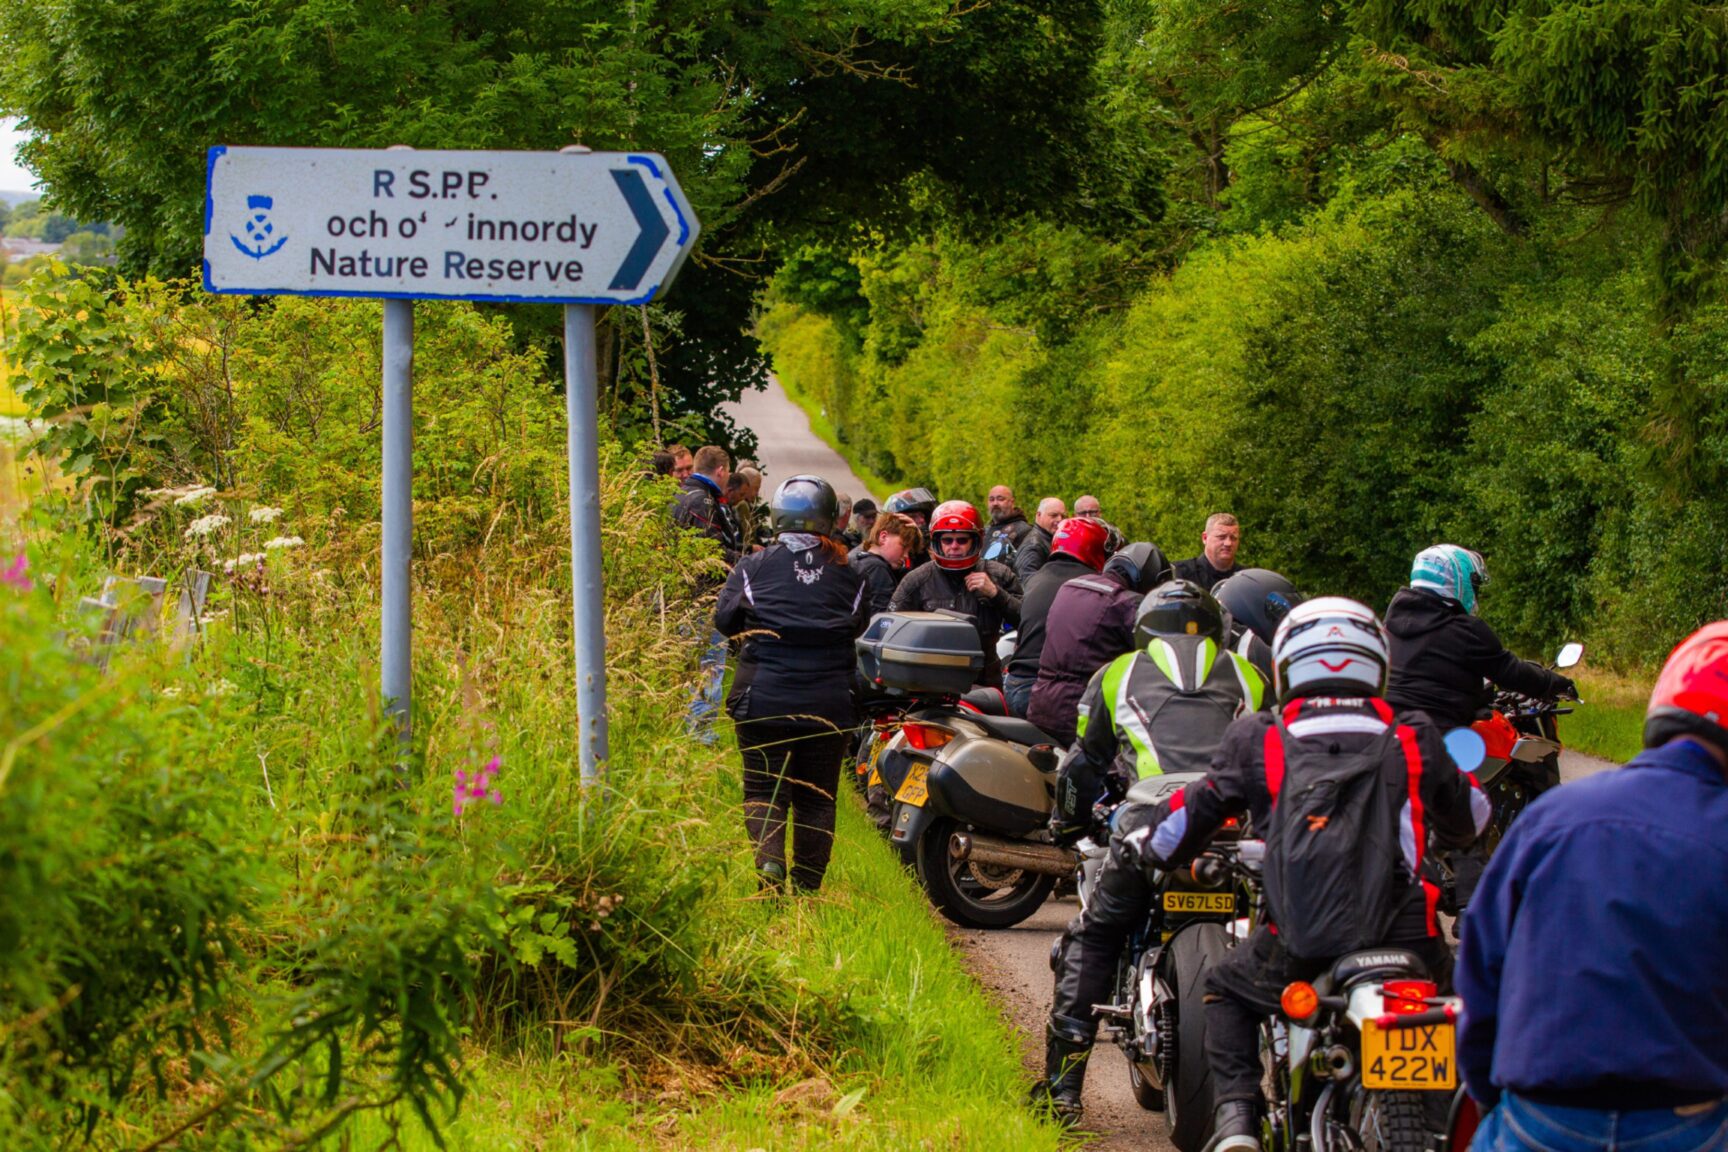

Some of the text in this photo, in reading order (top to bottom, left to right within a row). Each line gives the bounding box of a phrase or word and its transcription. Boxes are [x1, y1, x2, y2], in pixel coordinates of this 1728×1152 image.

[444, 212, 598, 249] innordy
[309, 247, 584, 282] Nature Reserve
[1167, 895, 1233, 910] SV67LSD
[1356, 954, 1410, 967] YAMAHA
[1369, 1055, 1449, 1082] 422W
